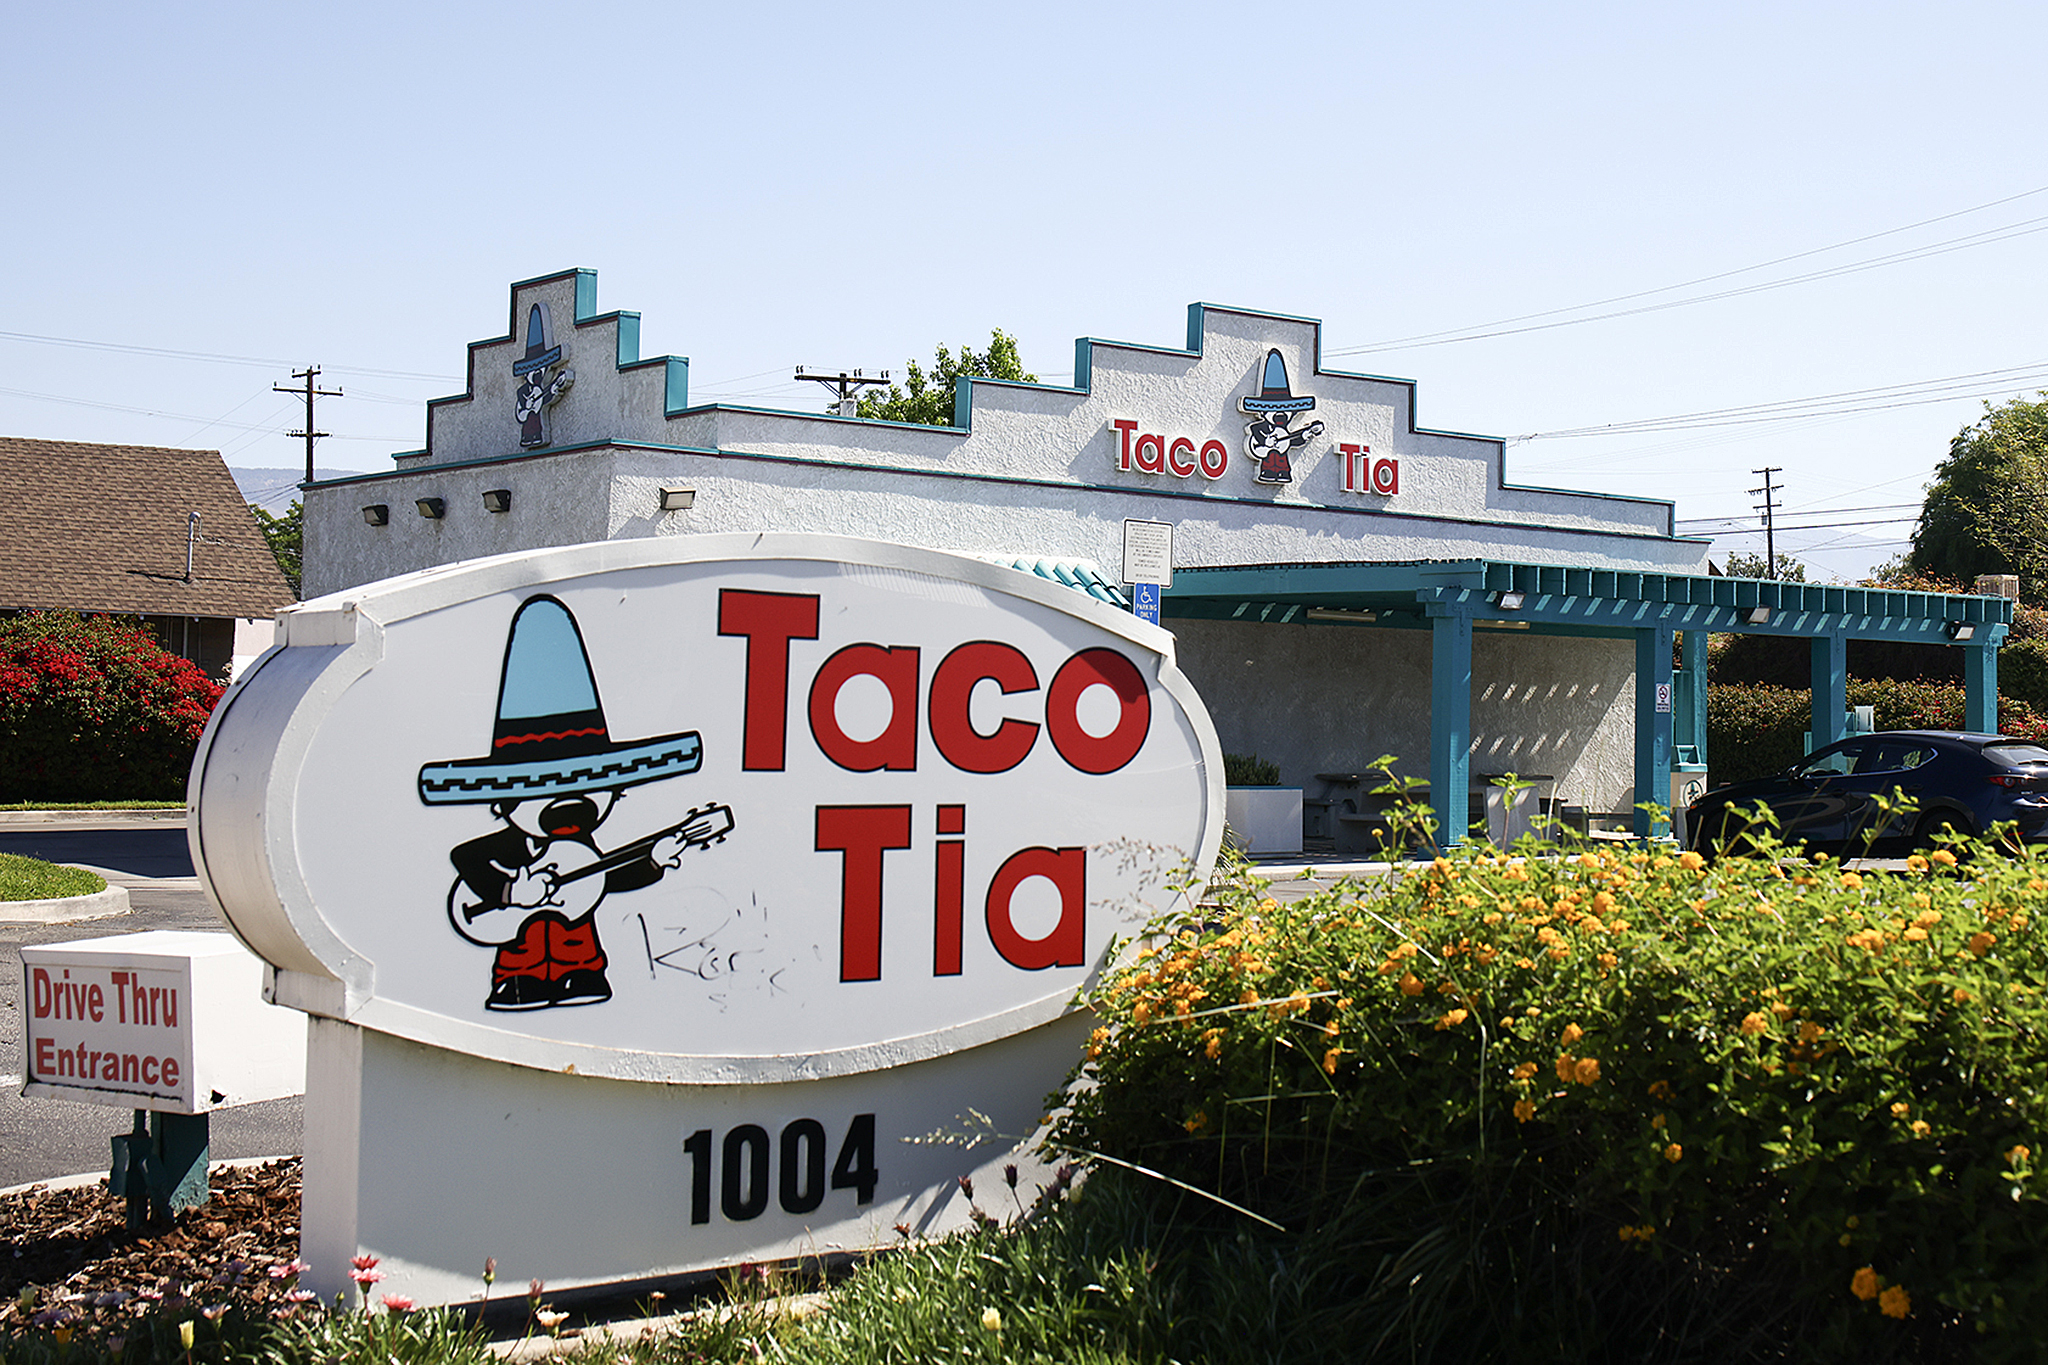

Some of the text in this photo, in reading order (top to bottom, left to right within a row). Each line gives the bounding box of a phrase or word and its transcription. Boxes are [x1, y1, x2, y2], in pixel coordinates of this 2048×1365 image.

[1112, 418, 1399, 495] Taco Tia
[1136, 603, 1157, 611] PARKING
[717, 588, 1152, 775] Taco
[815, 804, 1087, 983] Tia
[33, 967, 178, 1028] Drive Thru
[35, 1038, 180, 1087] Entrance
[683, 1113, 879, 1225] 1004
